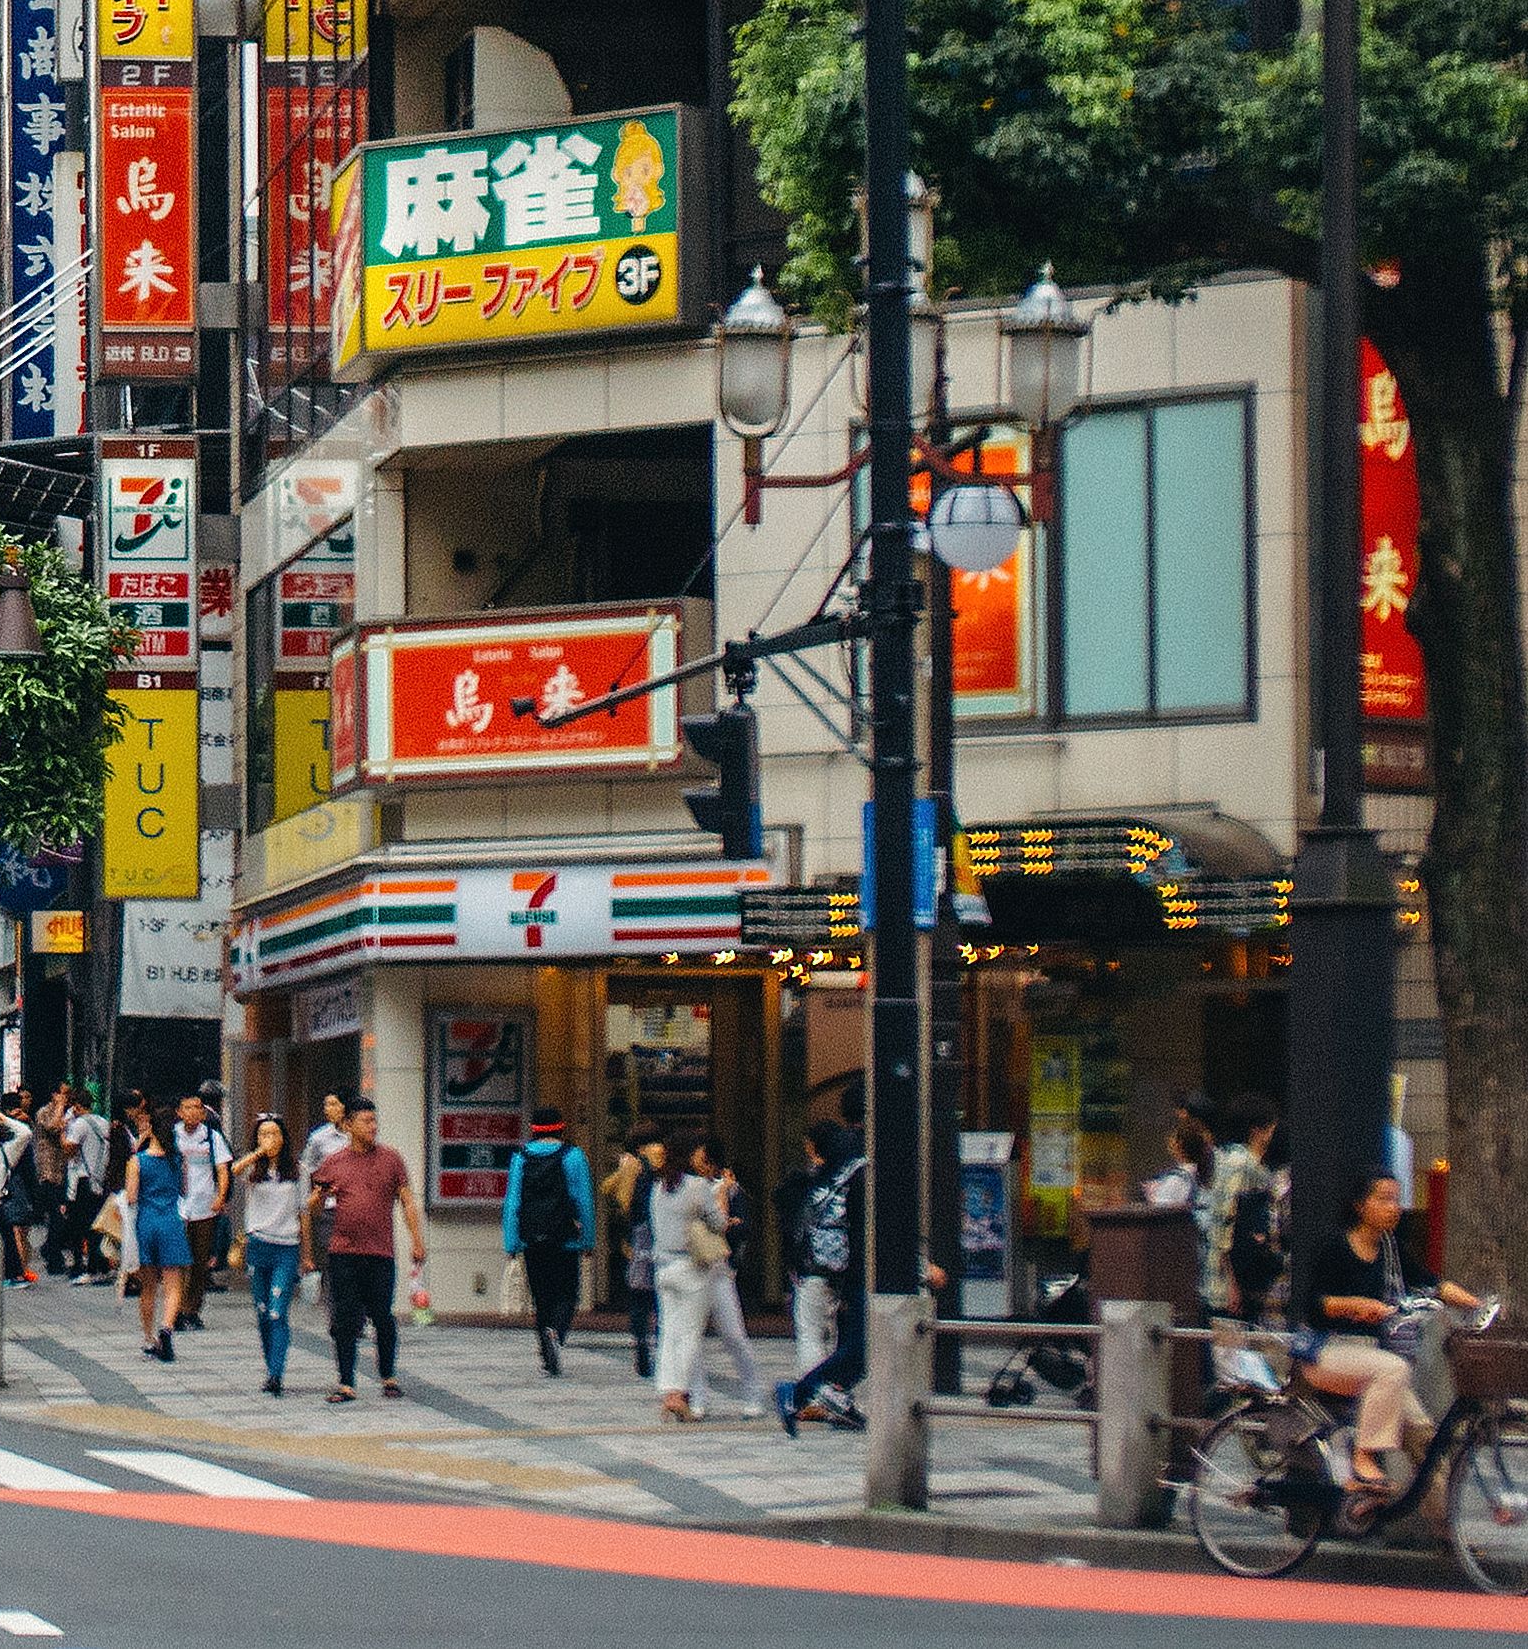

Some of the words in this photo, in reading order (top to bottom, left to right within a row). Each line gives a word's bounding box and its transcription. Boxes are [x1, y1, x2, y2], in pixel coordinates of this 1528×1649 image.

[119, 65, 171, 86] 2F
[109, 122, 156, 140] Salon
[379, 131, 604, 258] 麻雀
[381, 245, 607, 332] スリーファイブ
[616, 256, 661, 297] 3F
[118, 575, 178, 597] たばこ
[134, 603, 164, 627] 酒
[136, 674, 163, 689] B1
[136, 717, 166, 840] TUC
